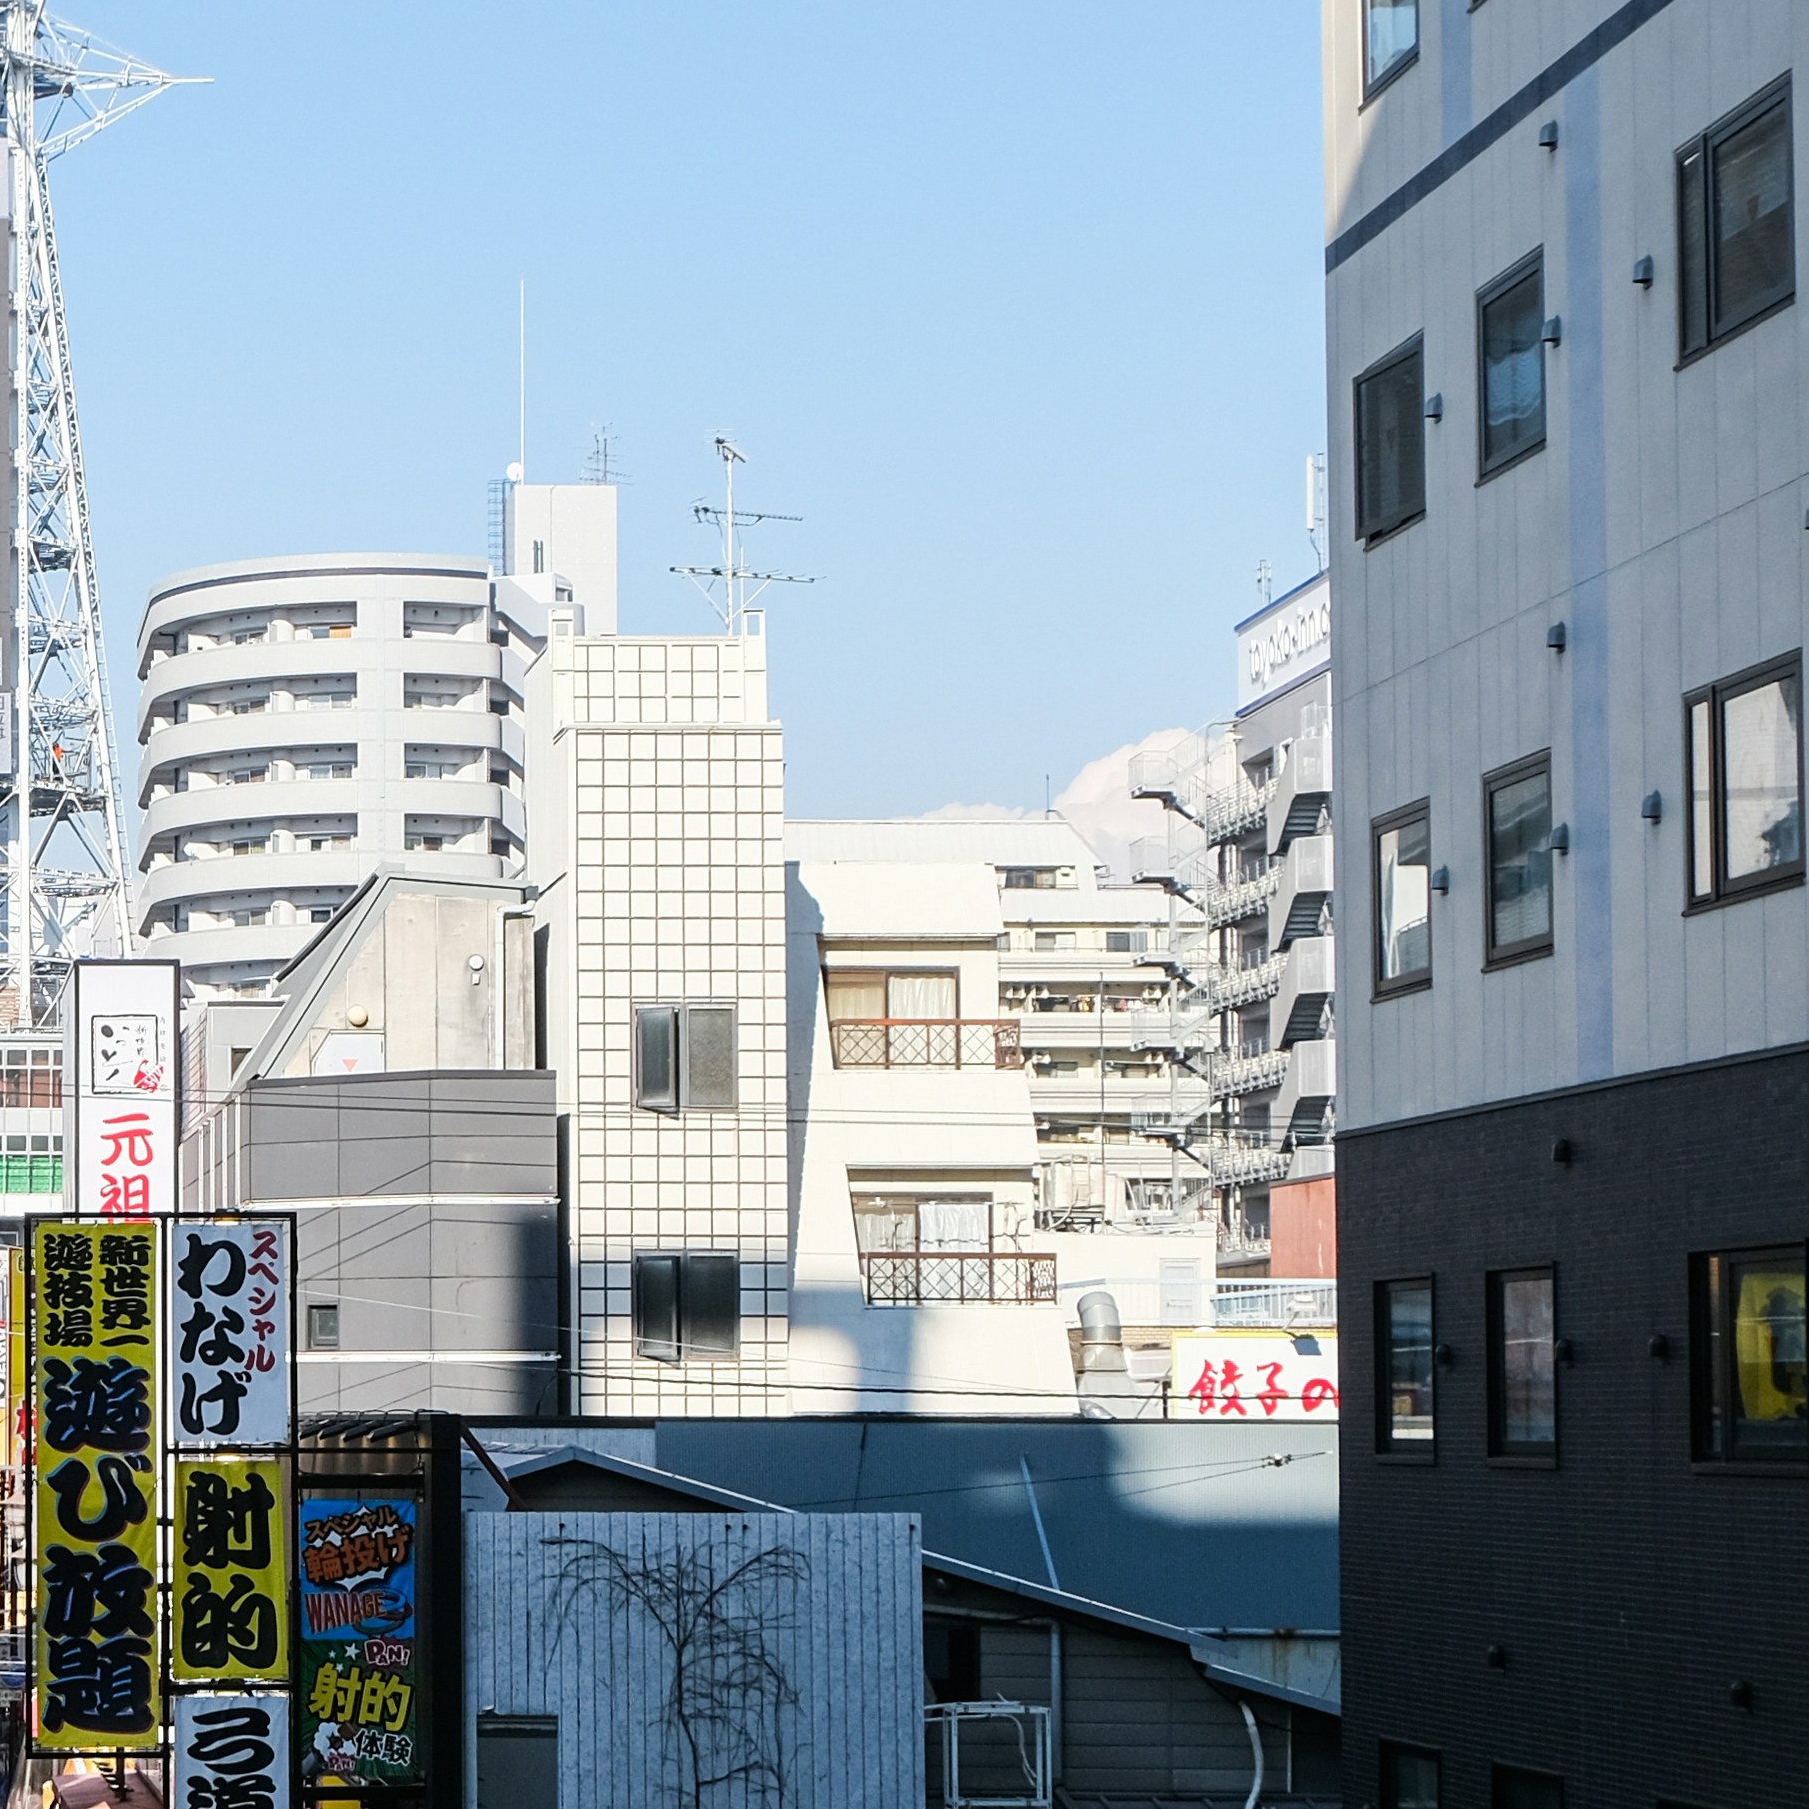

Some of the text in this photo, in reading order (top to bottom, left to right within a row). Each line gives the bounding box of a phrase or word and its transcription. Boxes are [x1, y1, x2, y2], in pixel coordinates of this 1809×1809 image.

[98, 1112, 154, 1223] 元祖
[178, 1233, 247, 1436] わなげ
[246, 1231, 278, 1373] スペシャル
[1188, 1358, 1339, 1416] 餃子の
[41, 1355, 154, 1734] 遊び放題
[303, 1525, 413, 1582] 輪投げ
[306, 1505, 397, 1541] スペシャル
[181, 1471, 278, 1669] 射的
[304, 1593, 386, 1634] WANAGE
[309, 1661, 412, 1732] 射的
[354, 1729, 413, 1766] 体験
